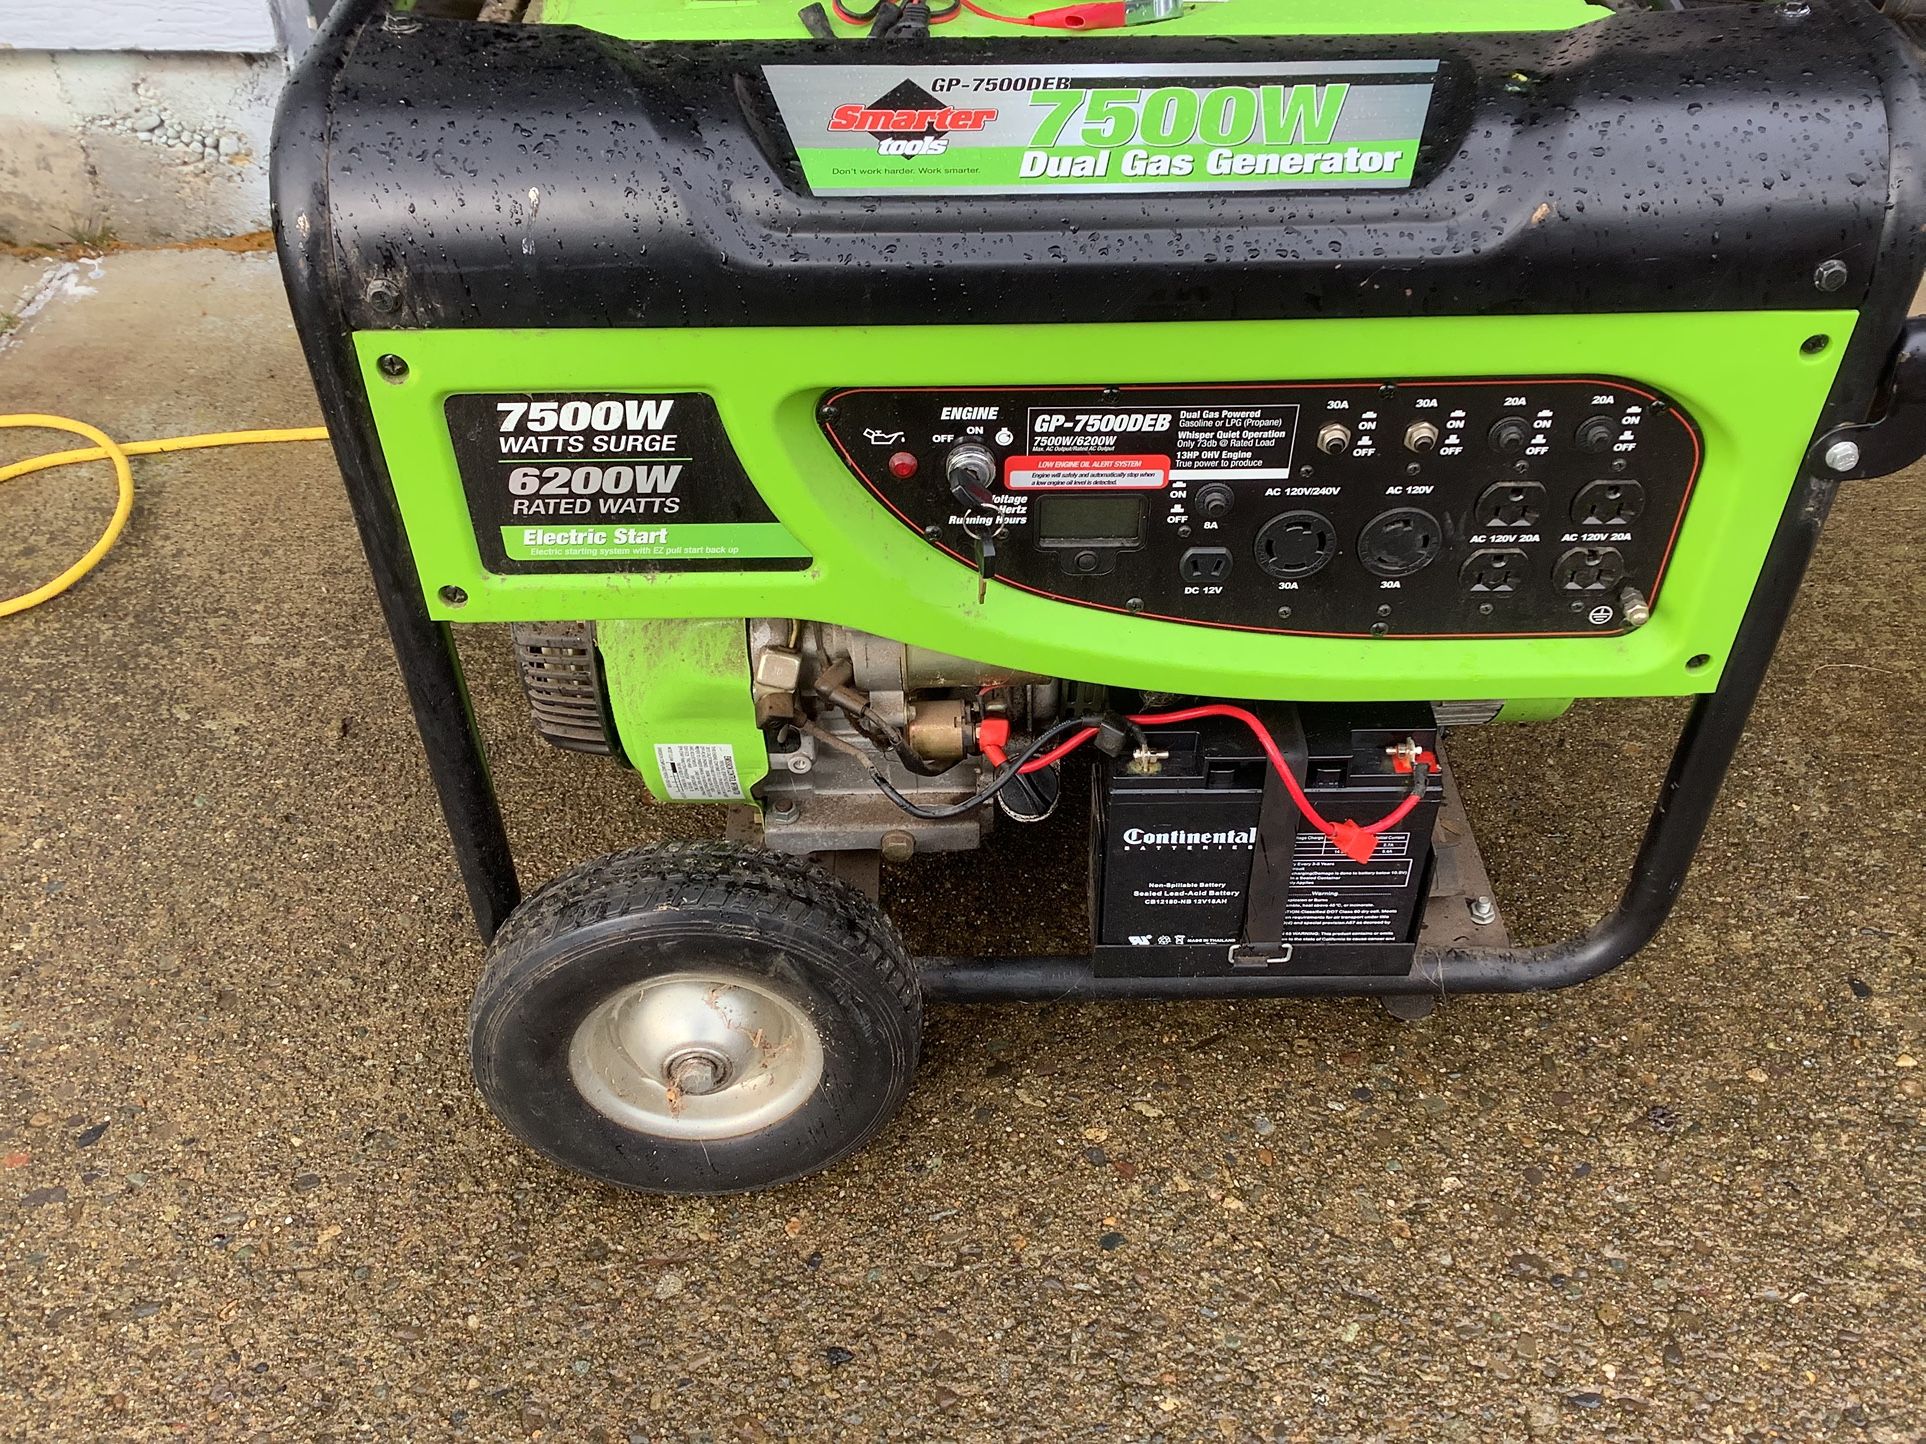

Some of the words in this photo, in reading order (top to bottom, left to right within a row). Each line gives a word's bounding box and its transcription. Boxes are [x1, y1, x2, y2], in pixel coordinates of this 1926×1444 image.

[931, 77, 1071, 92] GP-7500DEB
[827, 104, 999, 132] Smarter
[1025, 83, 1350, 149] 7500W
[877, 136, 949, 156] tools
[1019, 149, 1110, 179] Dual
[1120, 149, 1194, 178] Gas
[1205, 147, 1403, 176] Generator
[832, 167, 857, 175] Don't
[859, 167, 883, 175] work
[884, 167, 915, 175] harder.
[918, 167, 941, 175] Work
[944, 167, 981, 175] smarter.
[1326, 400, 1349, 409] 30A
[1415, 399, 1438, 408] 30A
[1503, 397, 1527, 406] 20A
[1591, 395, 1615, 405] 20A
[497, 399, 675, 432] 7500W
[940, 406, 999, 420] ENGINE
[1180, 410, 1200, 419] Dual
[1203, 410, 1219, 419] Gas
[1222, 409, 1261, 418] Powered
[1034, 413, 1172, 433] GP-7500DEB
[1179, 419, 1213, 428] Gasoline
[1225, 419, 1242, 427] LPG
[1243, 418, 1282, 428] (Propane)
[1446, 420, 1465, 429] ON
[1533, 420, 1552, 429] ON
[1621, 416, 1640, 425] ON
[966, 426, 984, 434] ON
[1358, 421, 1377, 430] ON
[932, 434, 954, 443] OFF
[1178, 431, 1215, 440] Whisper
[1216, 430, 1240, 439] Quiet
[1242, 430, 1286, 440] Operation
[499, 435, 585, 453] WATTS
[592, 434, 678, 453] SURGE
[1033, 435, 1117, 446] 7500W/6200W
[1177, 439, 1196, 449] Only
[1197, 439, 1218, 447] 73db
[1219, 439, 1229, 447] @
[1230, 438, 1254, 447] Rated
[1255, 438, 1275, 447] Load
[1439, 447, 1463, 455] OFF
[1525, 446, 1549, 455] OFF
[1613, 443, 1637, 452] OFF
[1176, 451, 1199, 459] 13HP
[1201, 451, 1220, 459] OHV
[1222, 450, 1252, 460] Engine
[1353, 448, 1376, 457] OFF
[1038, 460, 1055, 468] LOW
[1055, 460, 1079, 468] ENGINE
[1079, 460, 1090, 468] OIL
[1091, 460, 1113, 468] ALERT
[1114, 460, 1142, 468] SYSTEM
[1175, 459, 1192, 468] True
[1194, 460, 1219, 468] power
[1220, 459, 1229, 467] to
[1230, 459, 1263, 468] produce
[508, 465, 683, 495] 6200W
[1265, 487, 1282, 496] AC
[1284, 487, 1341, 496] 120V/240V
[1386, 486, 1403, 495] AC
[1405, 485, 1434, 494] 120V
[1170, 491, 1187, 499] ON
[512, 498, 591, 515] RATED
[599, 497, 681, 514] WATTS
[1167, 515, 1188, 523] OFF
[1203, 521, 1218, 529] 8A
[523, 528, 608, 546] Electric
[614, 527, 669, 545] Start
[1470, 535, 1487, 543] AC
[1489, 534, 1517, 543] 120V
[1518, 534, 1541, 542] 20A
[1561, 533, 1578, 542] AC
[1581, 533, 1609, 542] 120V
[1609, 532, 1632, 541] 20A
[530, 547, 562, 556] Electric
[564, 547, 598, 557] starting
[600, 547, 631, 557] system
[633, 546, 651, 555] with
[653, 546, 664, 555] EZ
[665, 546, 682, 556] pull
[684, 546, 705, 555] start
[706, 545, 726, 554] back
[728, 546, 740, 556] up
[1278, 581, 1299, 590] 30A
[1380, 581, 1402, 589] 30A
[1184, 586, 1200, 594] DC
[1203, 586, 1223, 594] 12V
[1123, 827, 1257, 845] Continental
[1199, 881, 1227, 889] Battery
[1163, 889, 1207, 897] Lead-Acid
[1208, 889, 1240, 898] Battery
